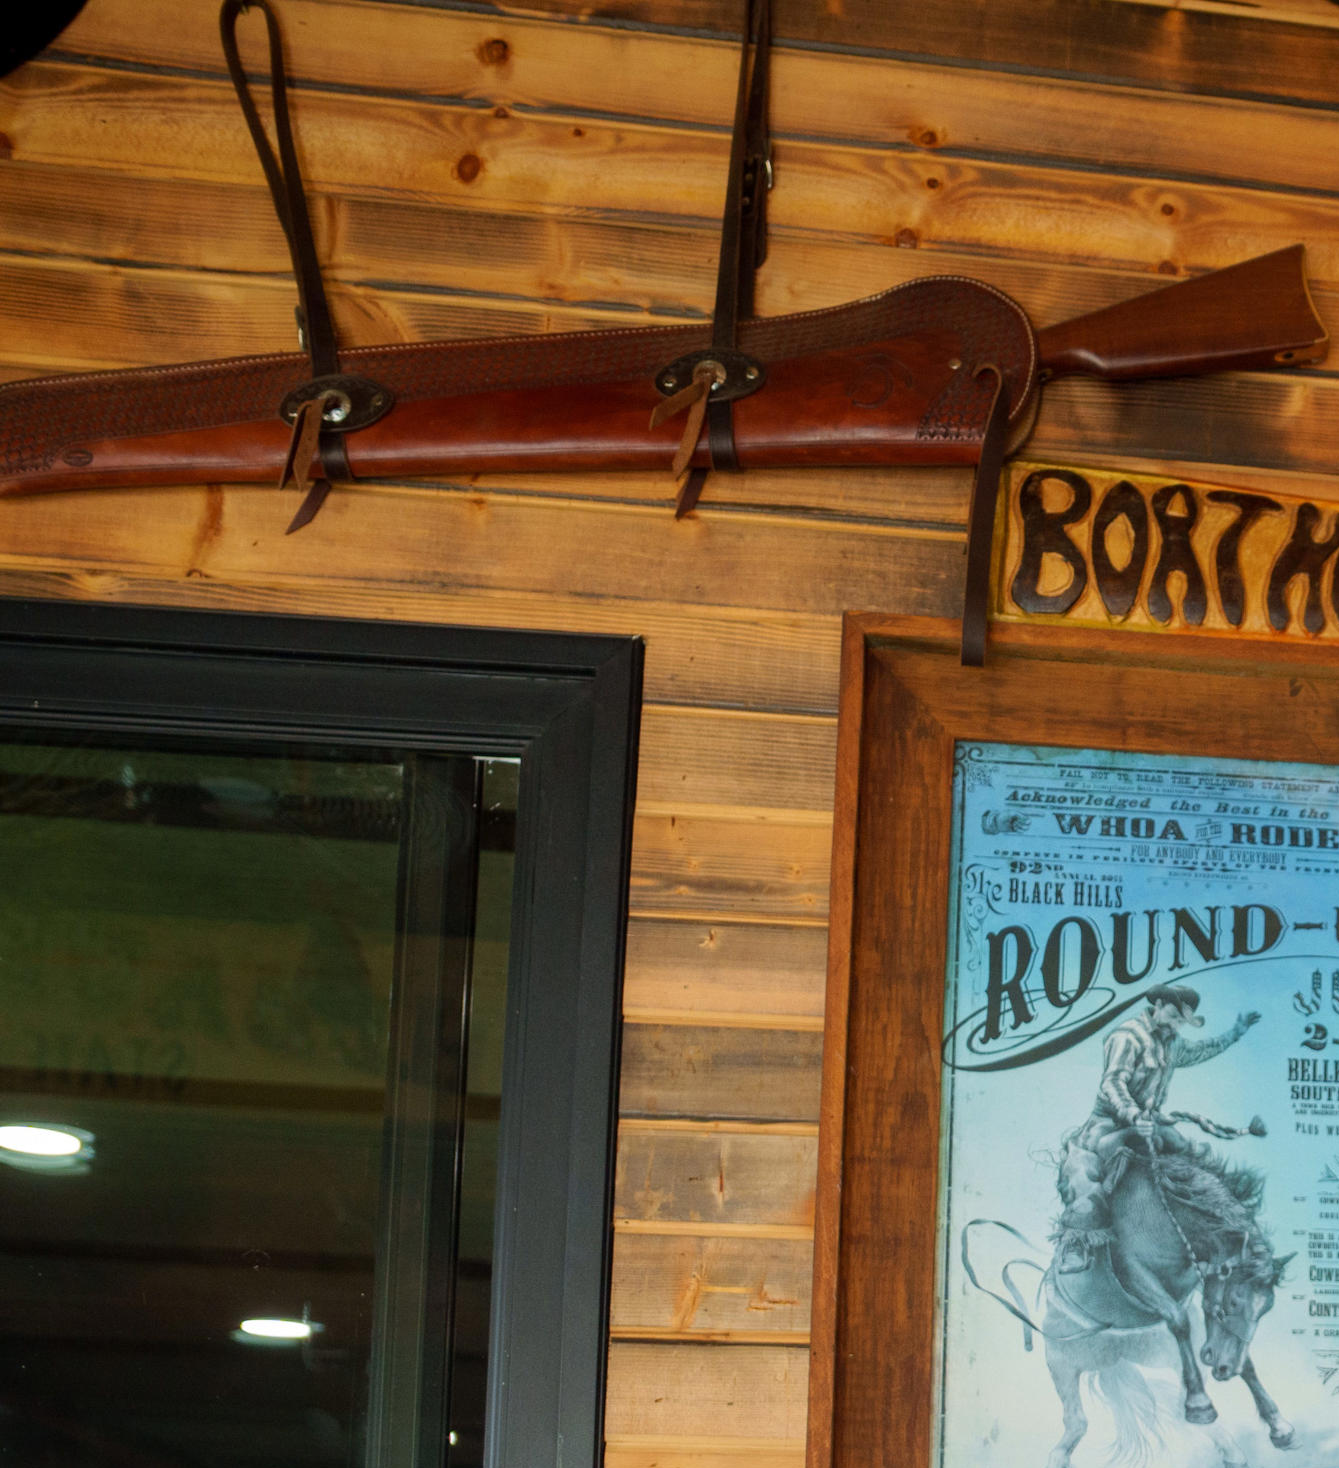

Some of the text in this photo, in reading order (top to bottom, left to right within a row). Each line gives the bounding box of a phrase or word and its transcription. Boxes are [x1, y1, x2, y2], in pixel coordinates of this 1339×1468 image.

[1006, 790, 1151, 810] Acknowledged
[1170, 799, 1203, 812] the
[1215, 802, 1260, 816] Best
[1270, 805, 1289, 818] in
[1299, 806, 1330, 820] the
[1053, 813, 1188, 841] WHOA
[1008, 877, 1124, 909] BLACK HILLS
